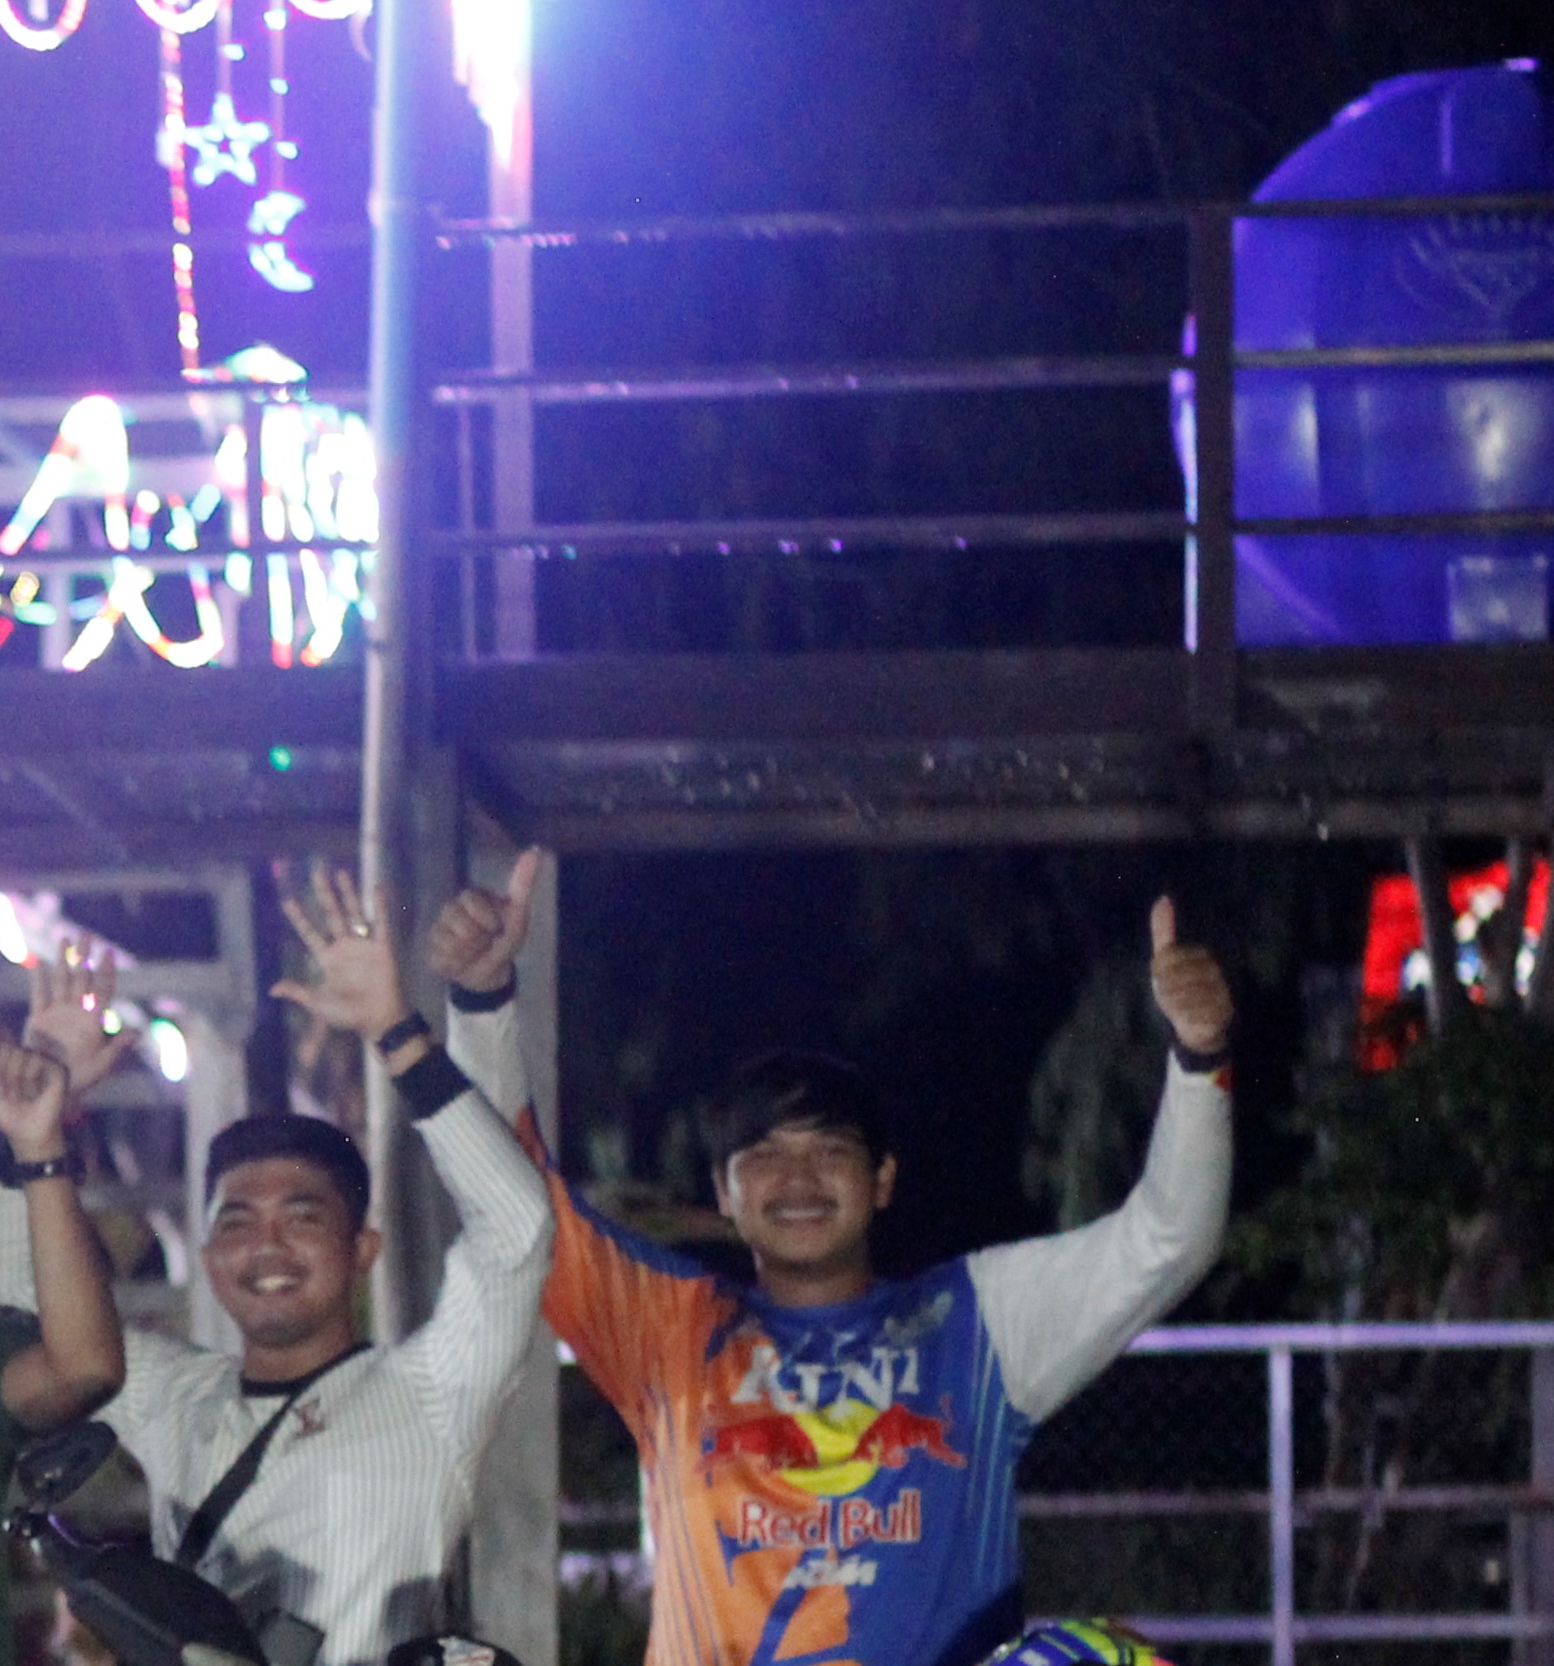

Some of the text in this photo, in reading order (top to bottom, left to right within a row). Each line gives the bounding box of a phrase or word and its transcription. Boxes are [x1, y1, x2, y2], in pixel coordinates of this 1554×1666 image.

[730, 1344, 920, 1422] KINI
[737, 1488, 922, 1550] Red Bull
